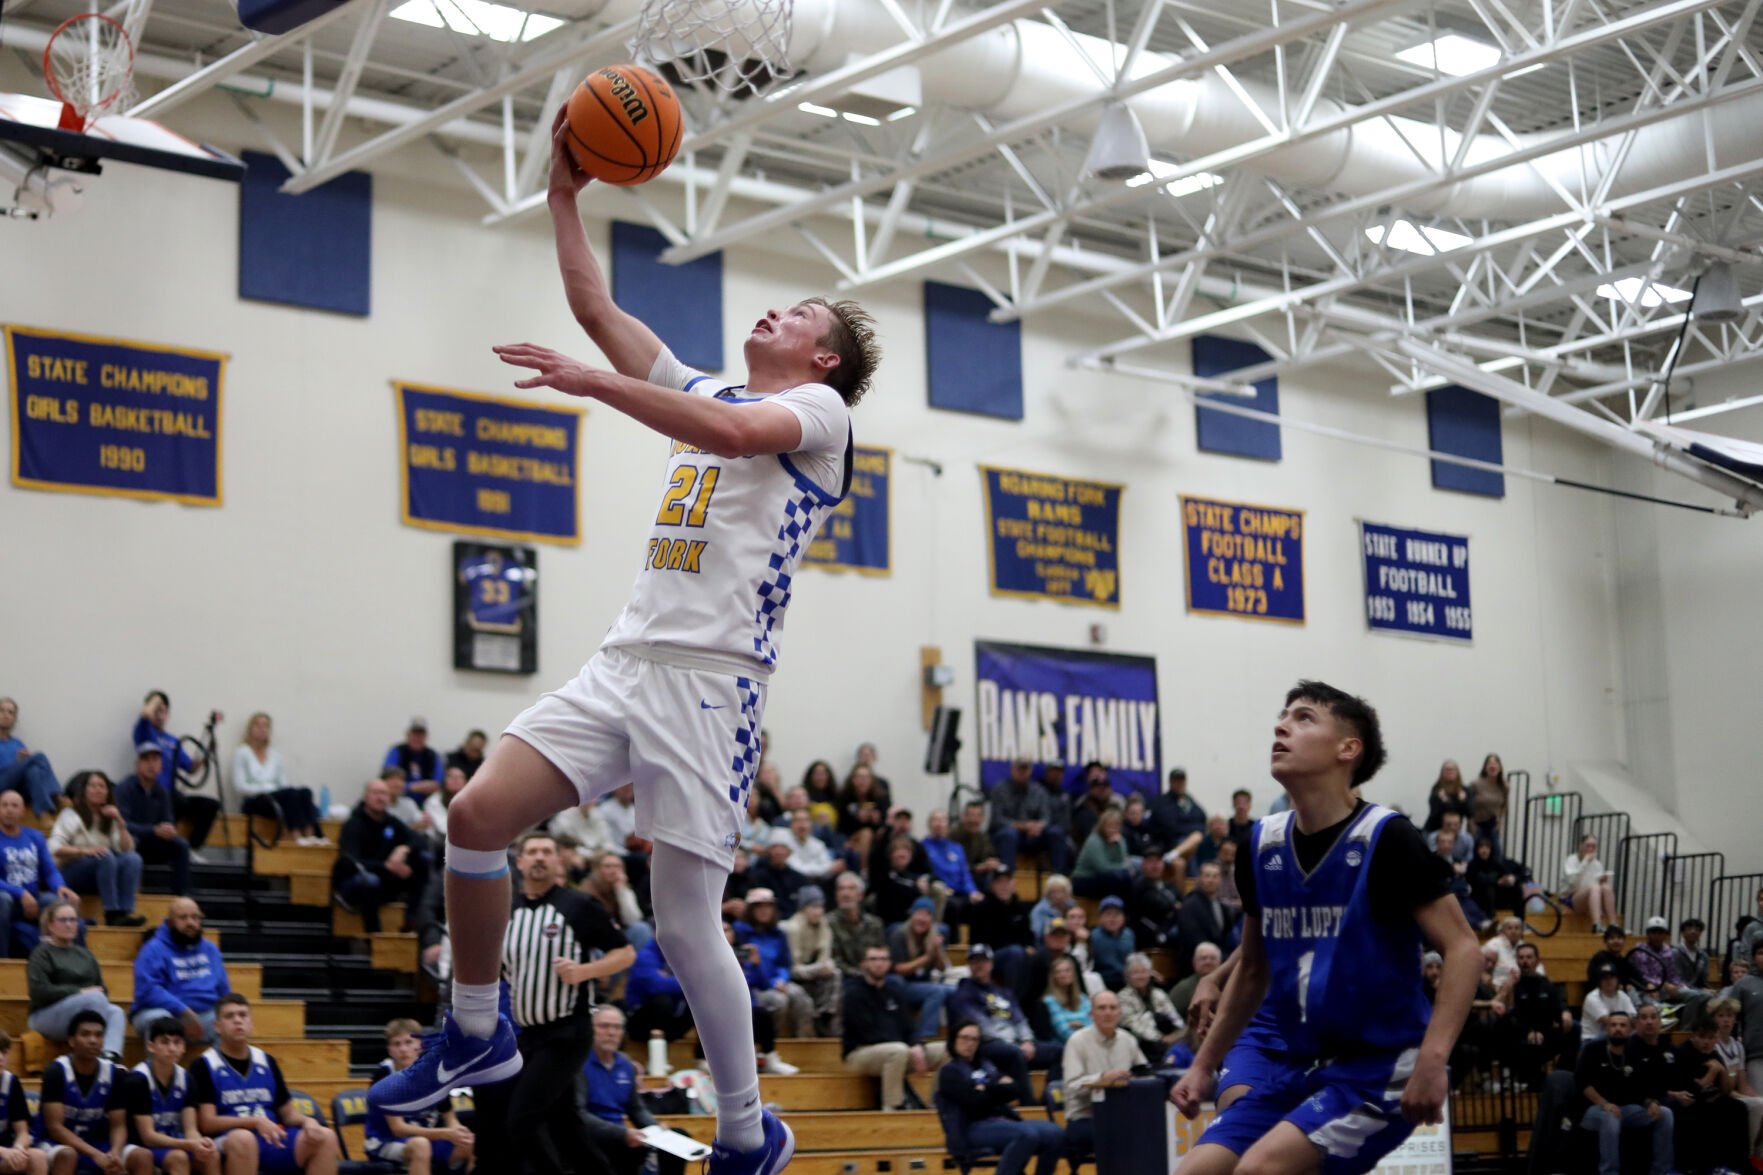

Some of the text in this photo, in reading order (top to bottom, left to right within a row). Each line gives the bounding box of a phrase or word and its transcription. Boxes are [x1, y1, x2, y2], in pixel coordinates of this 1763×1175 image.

[599, 67, 648, 126] Wilson
[27, 354, 208, 400] STATE CHAMPIONS
[26, 395, 211, 438] GIRLS BASKETBALL
[415, 409, 567, 450] STATE CHAMPIONS
[100, 445, 145, 472] 1990
[409, 444, 573, 486] GIRLS BASKETBALL
[655, 464, 721, 528] 21
[1187, 502, 1299, 540] STATE CHAMPS
[645, 538, 708, 574] FORK
[1202, 530, 1287, 565] FOOTBALL
[1365, 532, 1467, 568] STATE RUNNER UP
[1208, 557, 1284, 590] CLASS A
[1380, 565, 1457, 599] FOOTBALL
[1406, 600, 1435, 626] 1954
[978, 679, 1156, 771] RAMS FAMILY
[1301, 906, 1348, 938] LUPT
[1298, 951, 1315, 1023] 1
